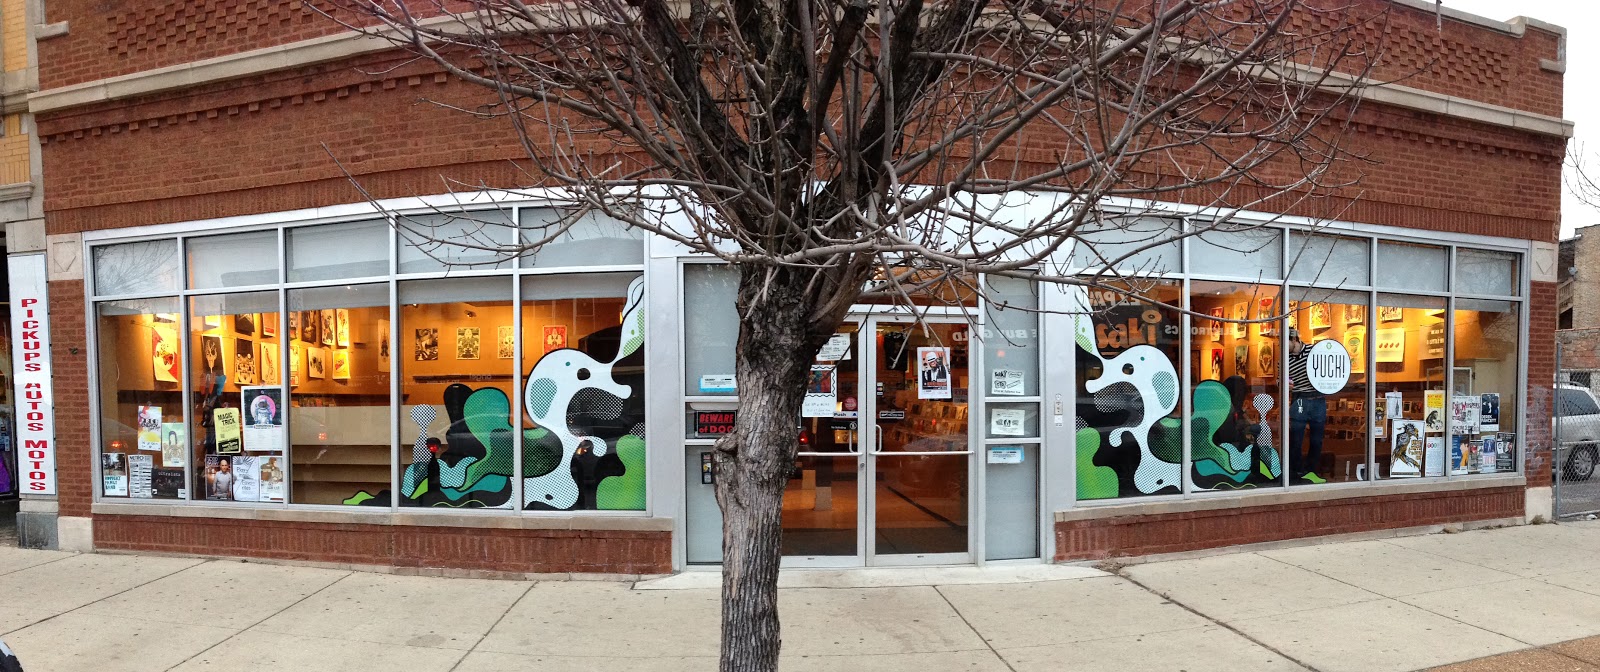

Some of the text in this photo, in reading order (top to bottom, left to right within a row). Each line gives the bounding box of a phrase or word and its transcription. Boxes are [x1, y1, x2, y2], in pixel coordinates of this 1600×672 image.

[21, 298, 41, 372] PICKUPS
[1312, 353, 1345, 379] YUCK!
[24, 382, 43, 431] AUTOS
[217, 412, 233, 420] MAGIC
[700, 413, 734, 423] BEWARE
[221, 418, 236, 426] TRICK
[24, 439, 48, 491] MOTOS
